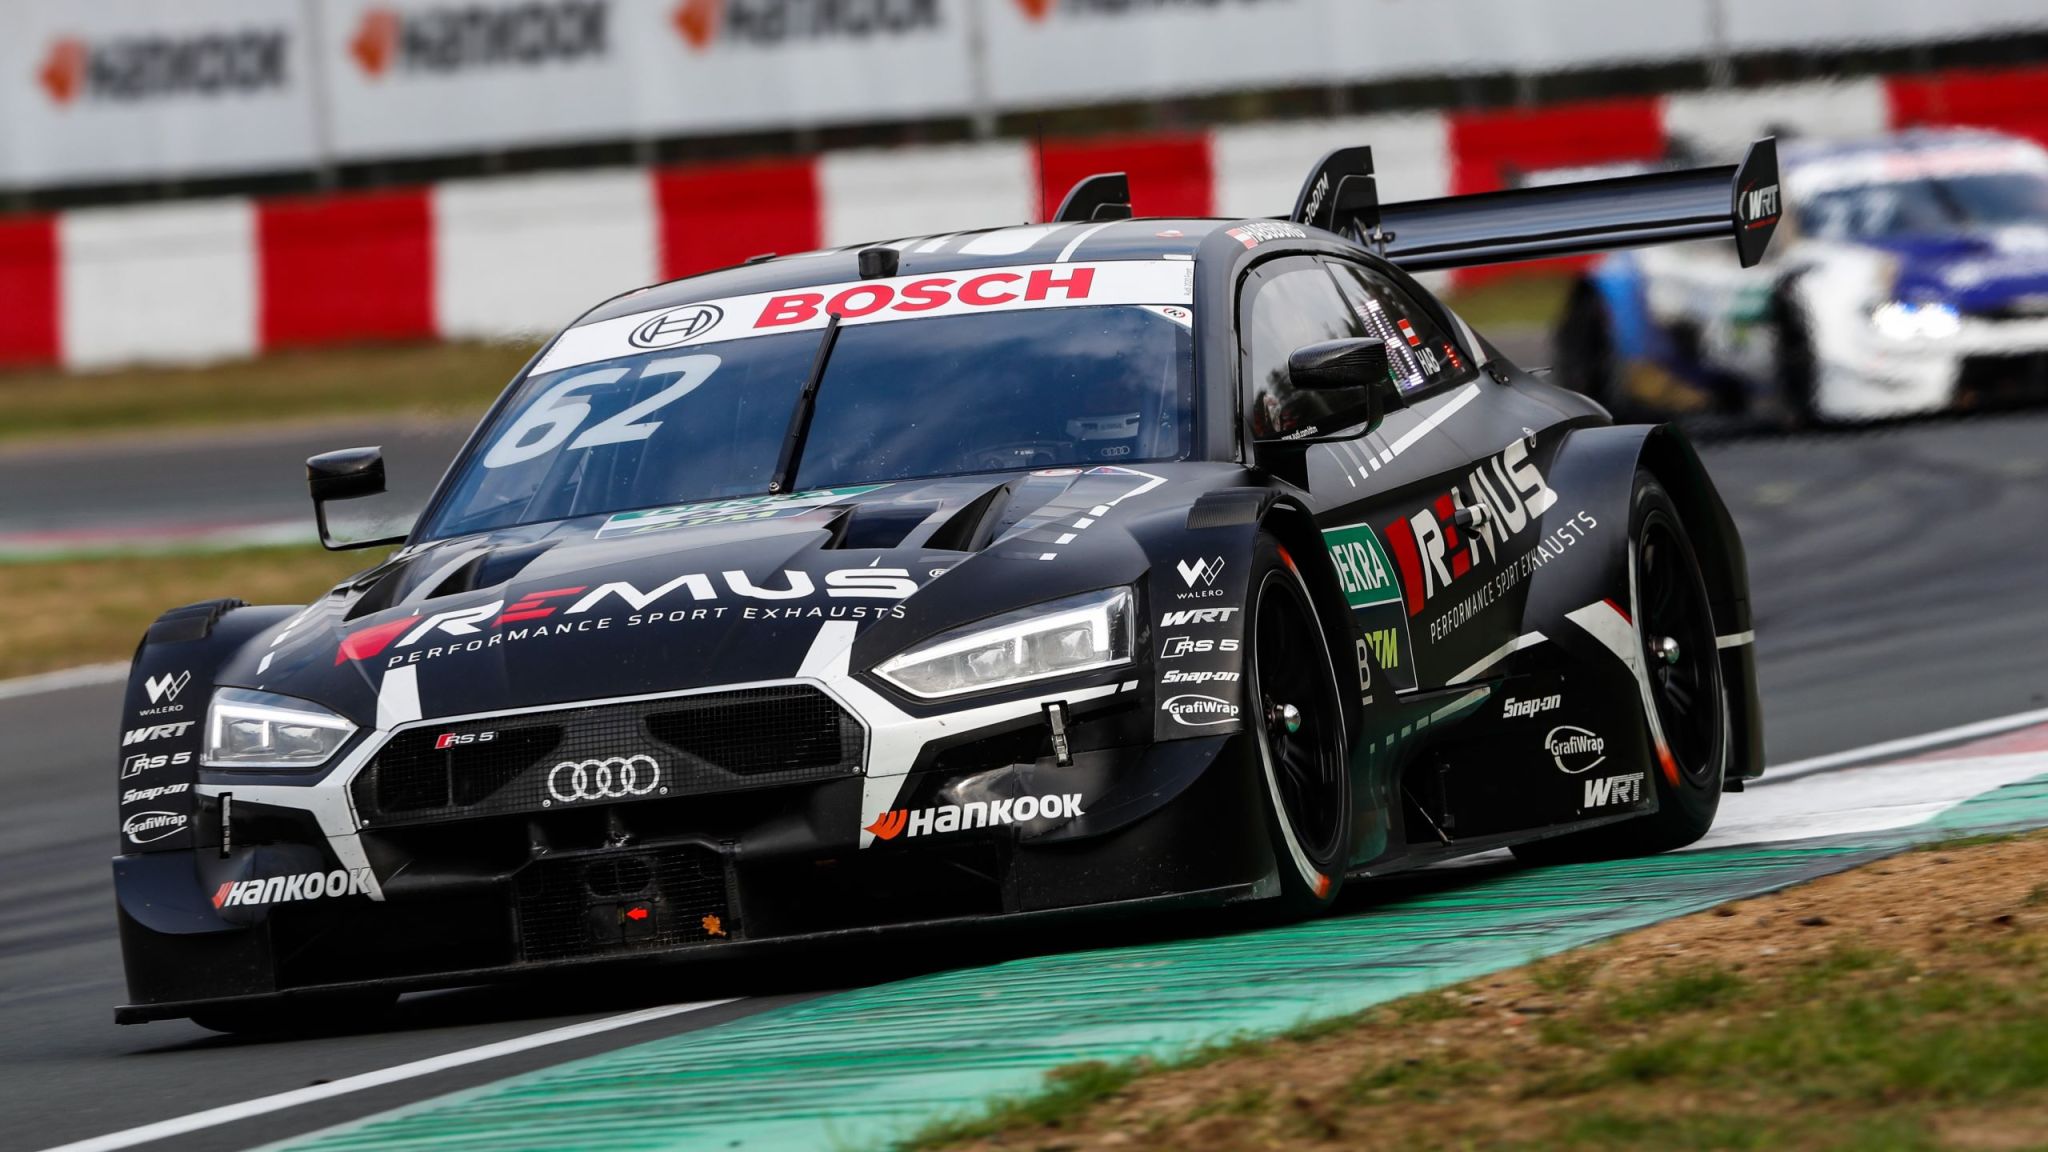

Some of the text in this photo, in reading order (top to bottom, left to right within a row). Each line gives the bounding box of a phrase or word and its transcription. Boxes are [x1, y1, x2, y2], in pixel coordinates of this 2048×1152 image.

[1749, 184, 1778, 220] WRT
[752, 267, 1097, 328] BOSCH
[1415, 347, 1441, 376] HAB
[483, 354, 722, 469] 62
[1410, 438, 1558, 600] REMUS
[1176, 589, 1224, 600] WALERO
[394, 567, 919, 649] REMUS
[1160, 607, 1239, 628] WRT
[1430, 582, 1495, 645] PERFORMANCE
[387, 606, 907, 668] PERFORMANCE SPORT EXHAUSTS
[1219, 639, 1239, 652] 5
[1161, 669, 1240, 684] Snap-on
[139, 704, 184, 716] WALERO
[1168, 701, 1239, 716] GrafiWrap
[1503, 694, 1562, 719] Snap-on
[122, 720, 196, 747] WRT
[478, 731, 495, 743] 5
[171, 751, 192, 765] 5
[1550, 735, 1605, 757] GrafiWrap
[121, 783, 190, 806] Snap-on
[1584, 772, 1644, 808] WRT
[126, 815, 188, 835] GrafiWrap
